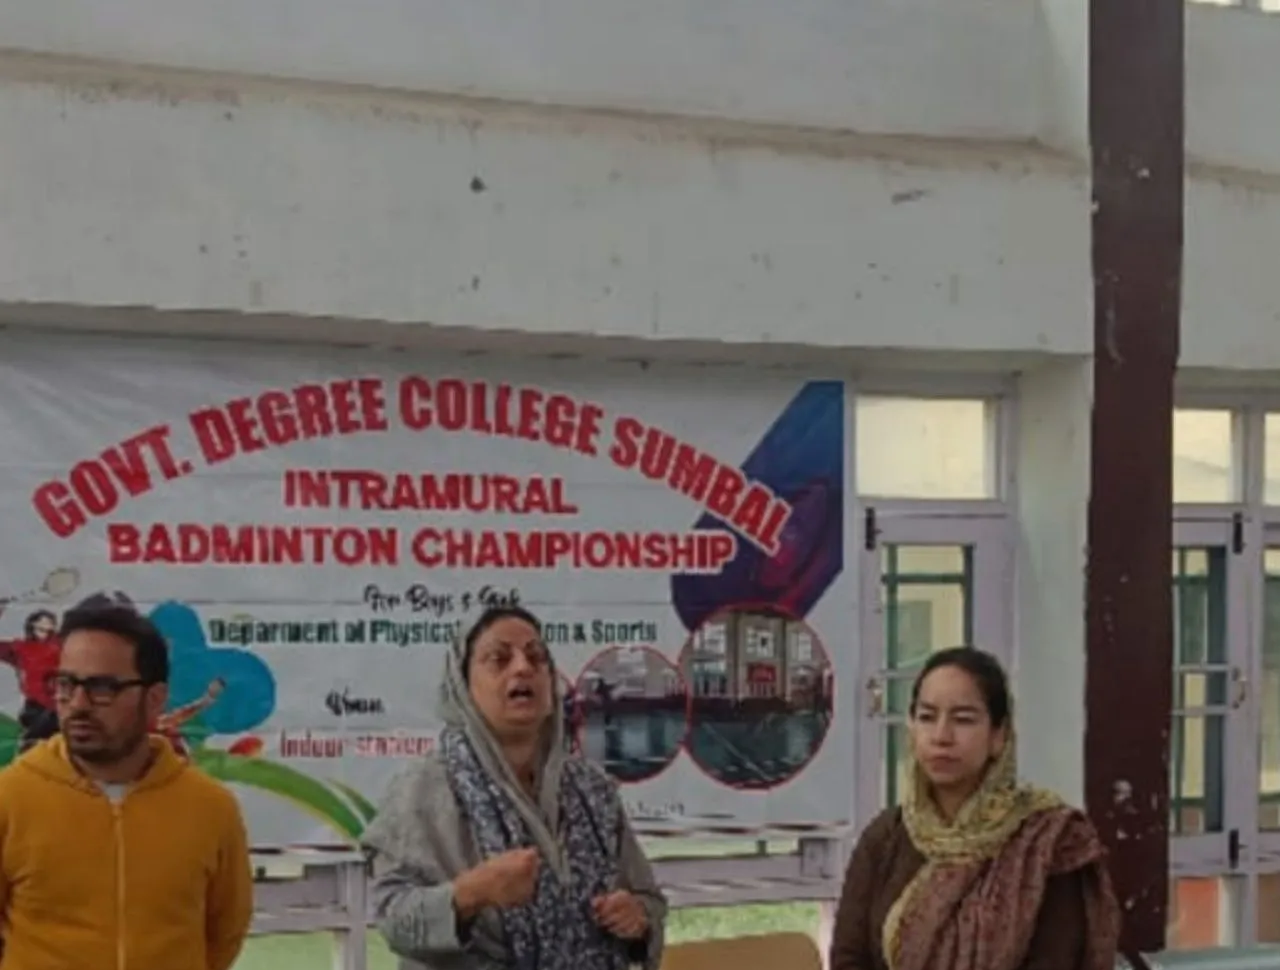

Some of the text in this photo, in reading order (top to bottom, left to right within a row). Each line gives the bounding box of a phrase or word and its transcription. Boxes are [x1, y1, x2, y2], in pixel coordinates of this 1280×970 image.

[32, 375, 792, 555] GOVT. DEGREE COLLEGE SUMBAL
[284, 470, 578, 514] INTRAMURAL
[106, 523, 736, 572] BADMINTON CHAMPIONSHIP
[345, 619, 365, 643] of
[370, 619, 460, 648] Physica
[591, 618, 657, 644] Sports
